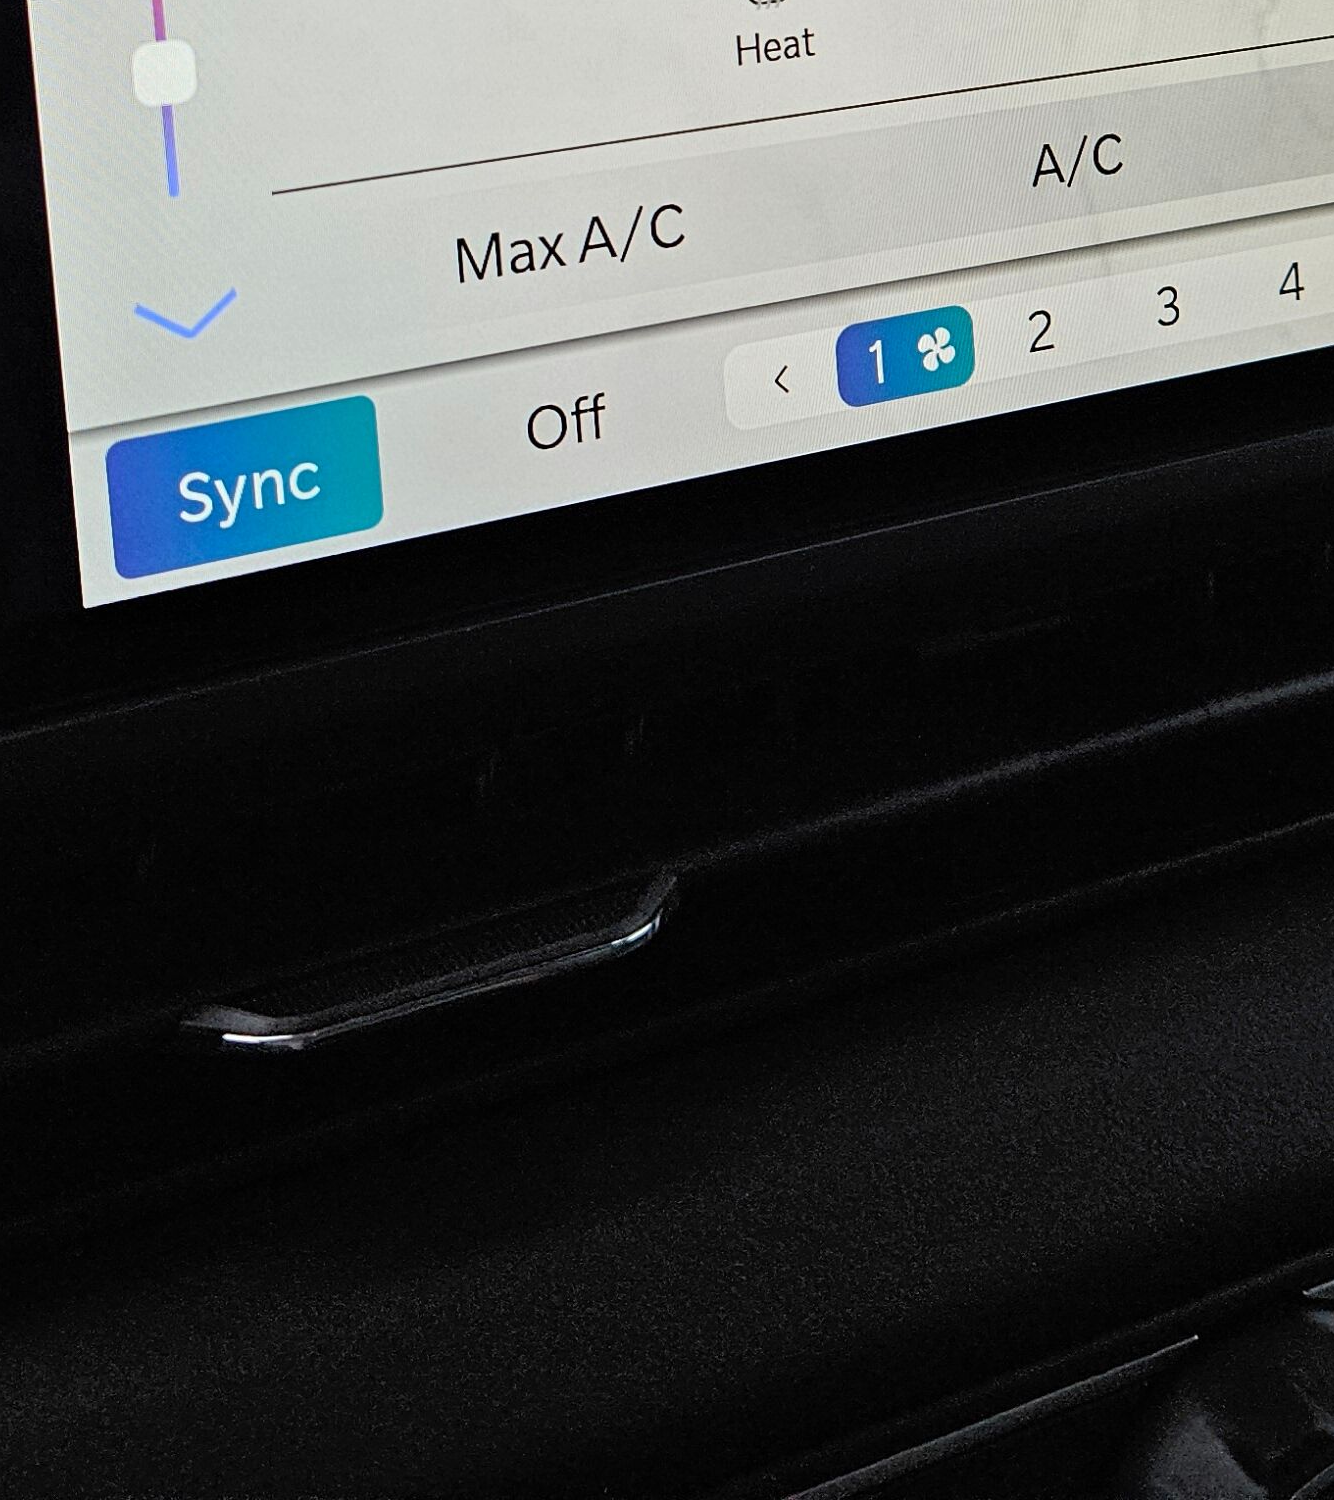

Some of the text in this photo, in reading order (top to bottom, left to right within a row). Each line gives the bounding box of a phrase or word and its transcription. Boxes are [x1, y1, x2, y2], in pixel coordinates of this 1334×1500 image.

[736, 28, 816, 66] Heat
[1032, 133, 1123, 188] A/C
[456, 203, 685, 284] Max A/C
[868, 339, 885, 384] 1
[1028, 309, 1055, 353] 2
[1157, 285, 1180, 327] 3
[1279, 261, 1305, 301] 4
[527, 392, 606, 450] Off
[179, 462, 321, 529] Sync
